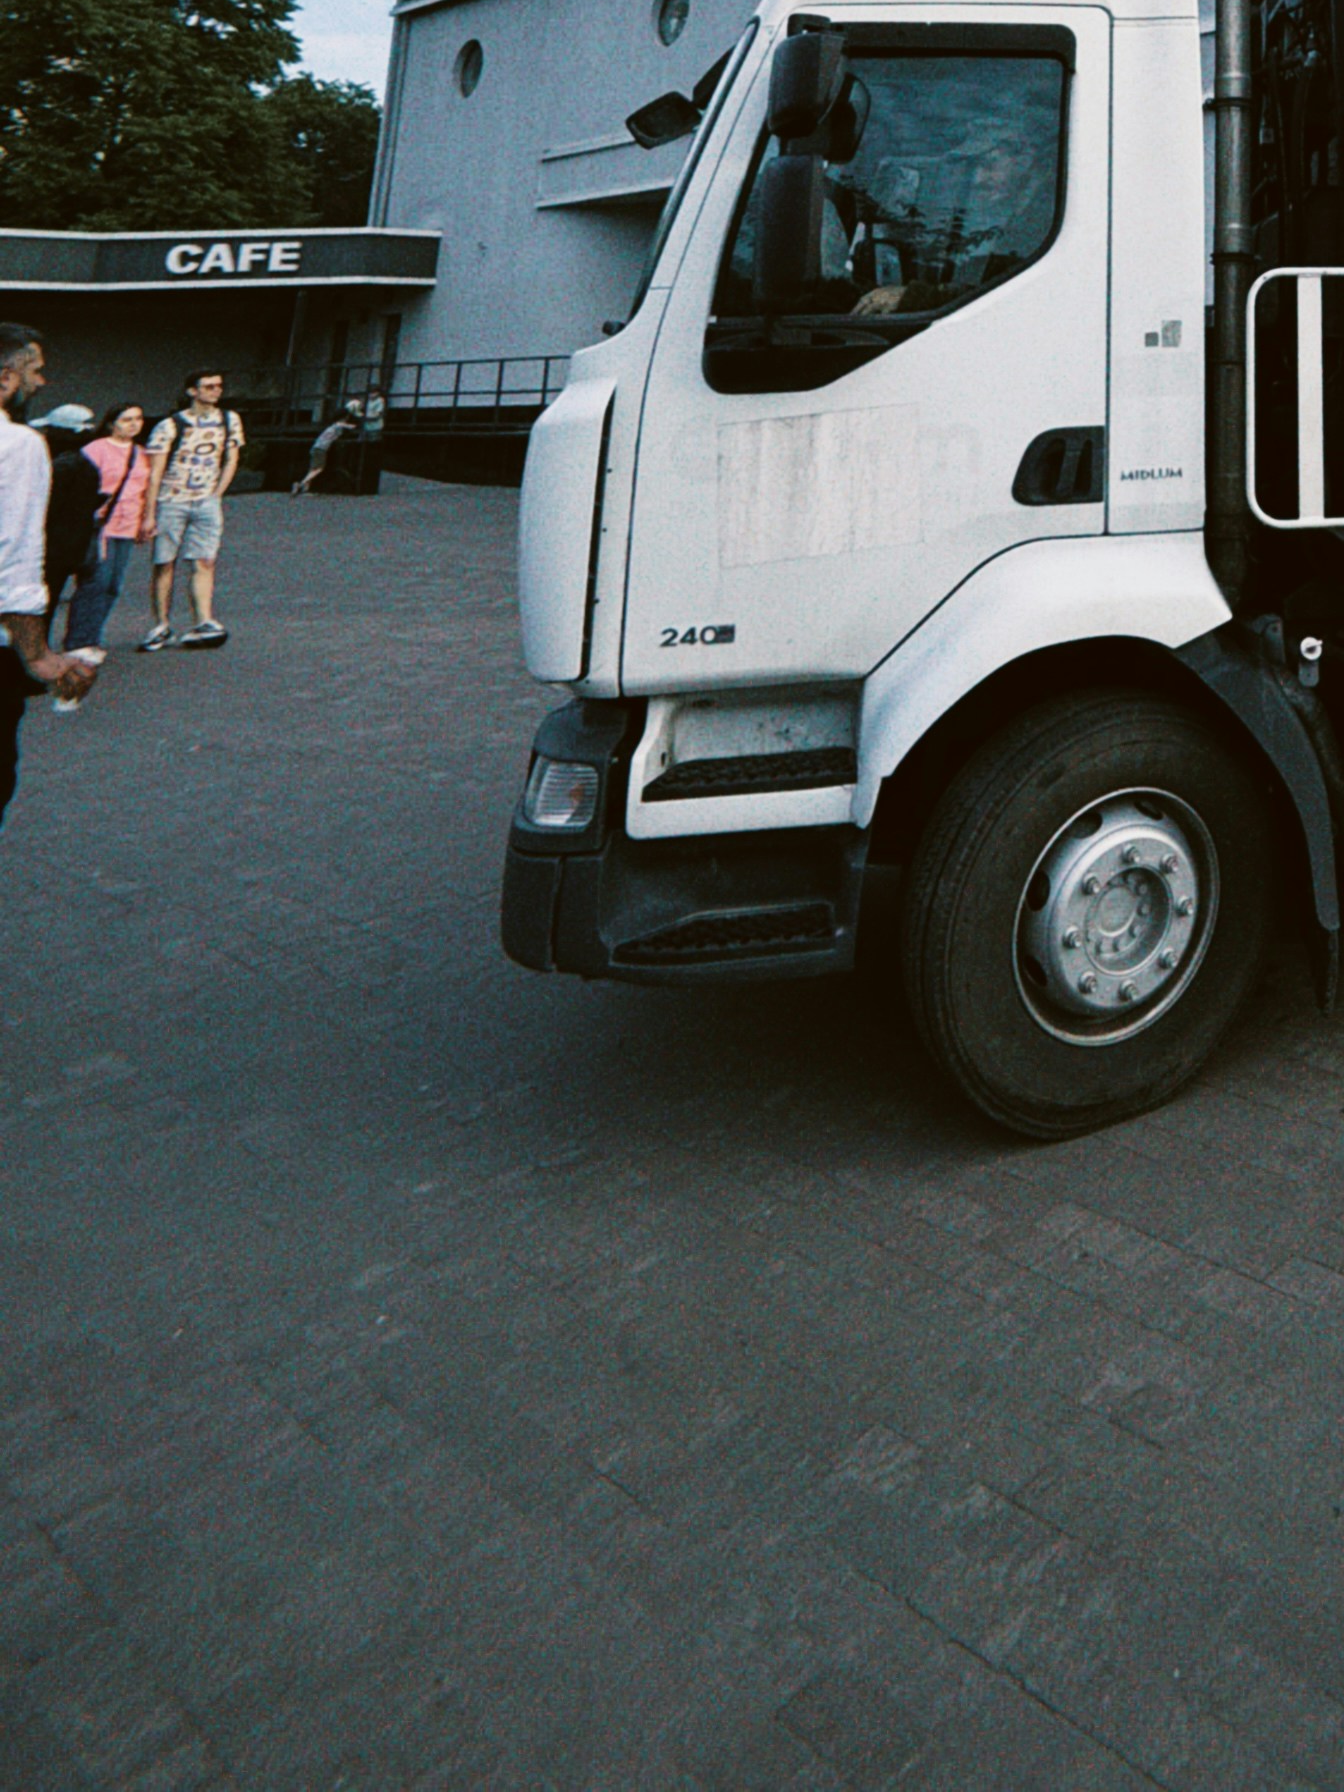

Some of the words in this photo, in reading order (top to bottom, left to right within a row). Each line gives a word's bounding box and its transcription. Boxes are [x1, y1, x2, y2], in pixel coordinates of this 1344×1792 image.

[165, 241, 303, 275] CAFE
[1120, 467, 1183, 481] MIDLUM
[659, 625, 718, 648] 240
